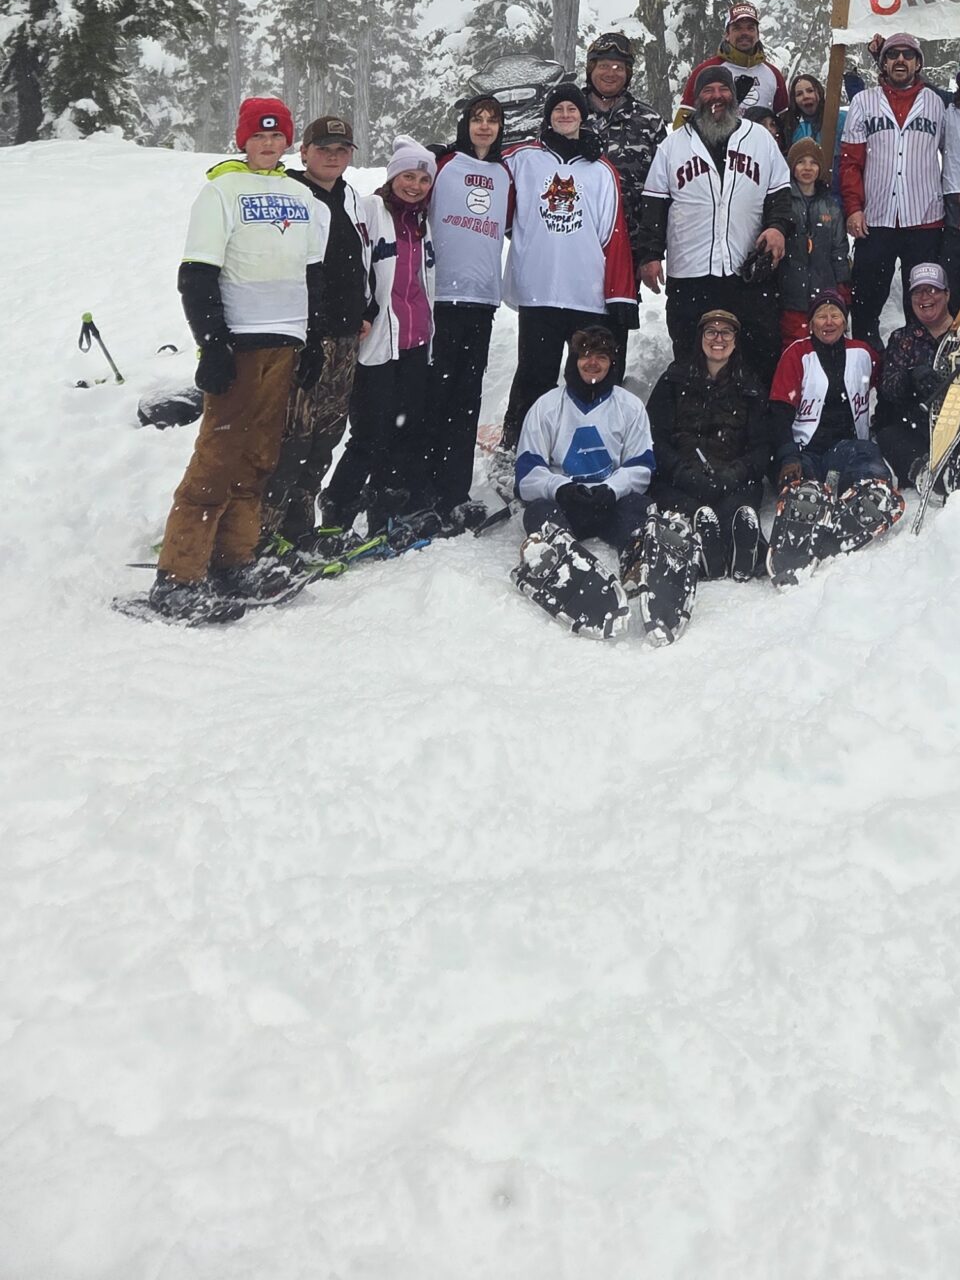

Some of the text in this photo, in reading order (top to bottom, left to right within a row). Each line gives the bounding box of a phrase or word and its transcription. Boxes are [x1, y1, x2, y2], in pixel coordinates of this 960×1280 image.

[864, 115, 937, 138] MARNERS
[465, 174, 494, 190] CUBA
[245, 207, 306, 220] EVERY DAY
